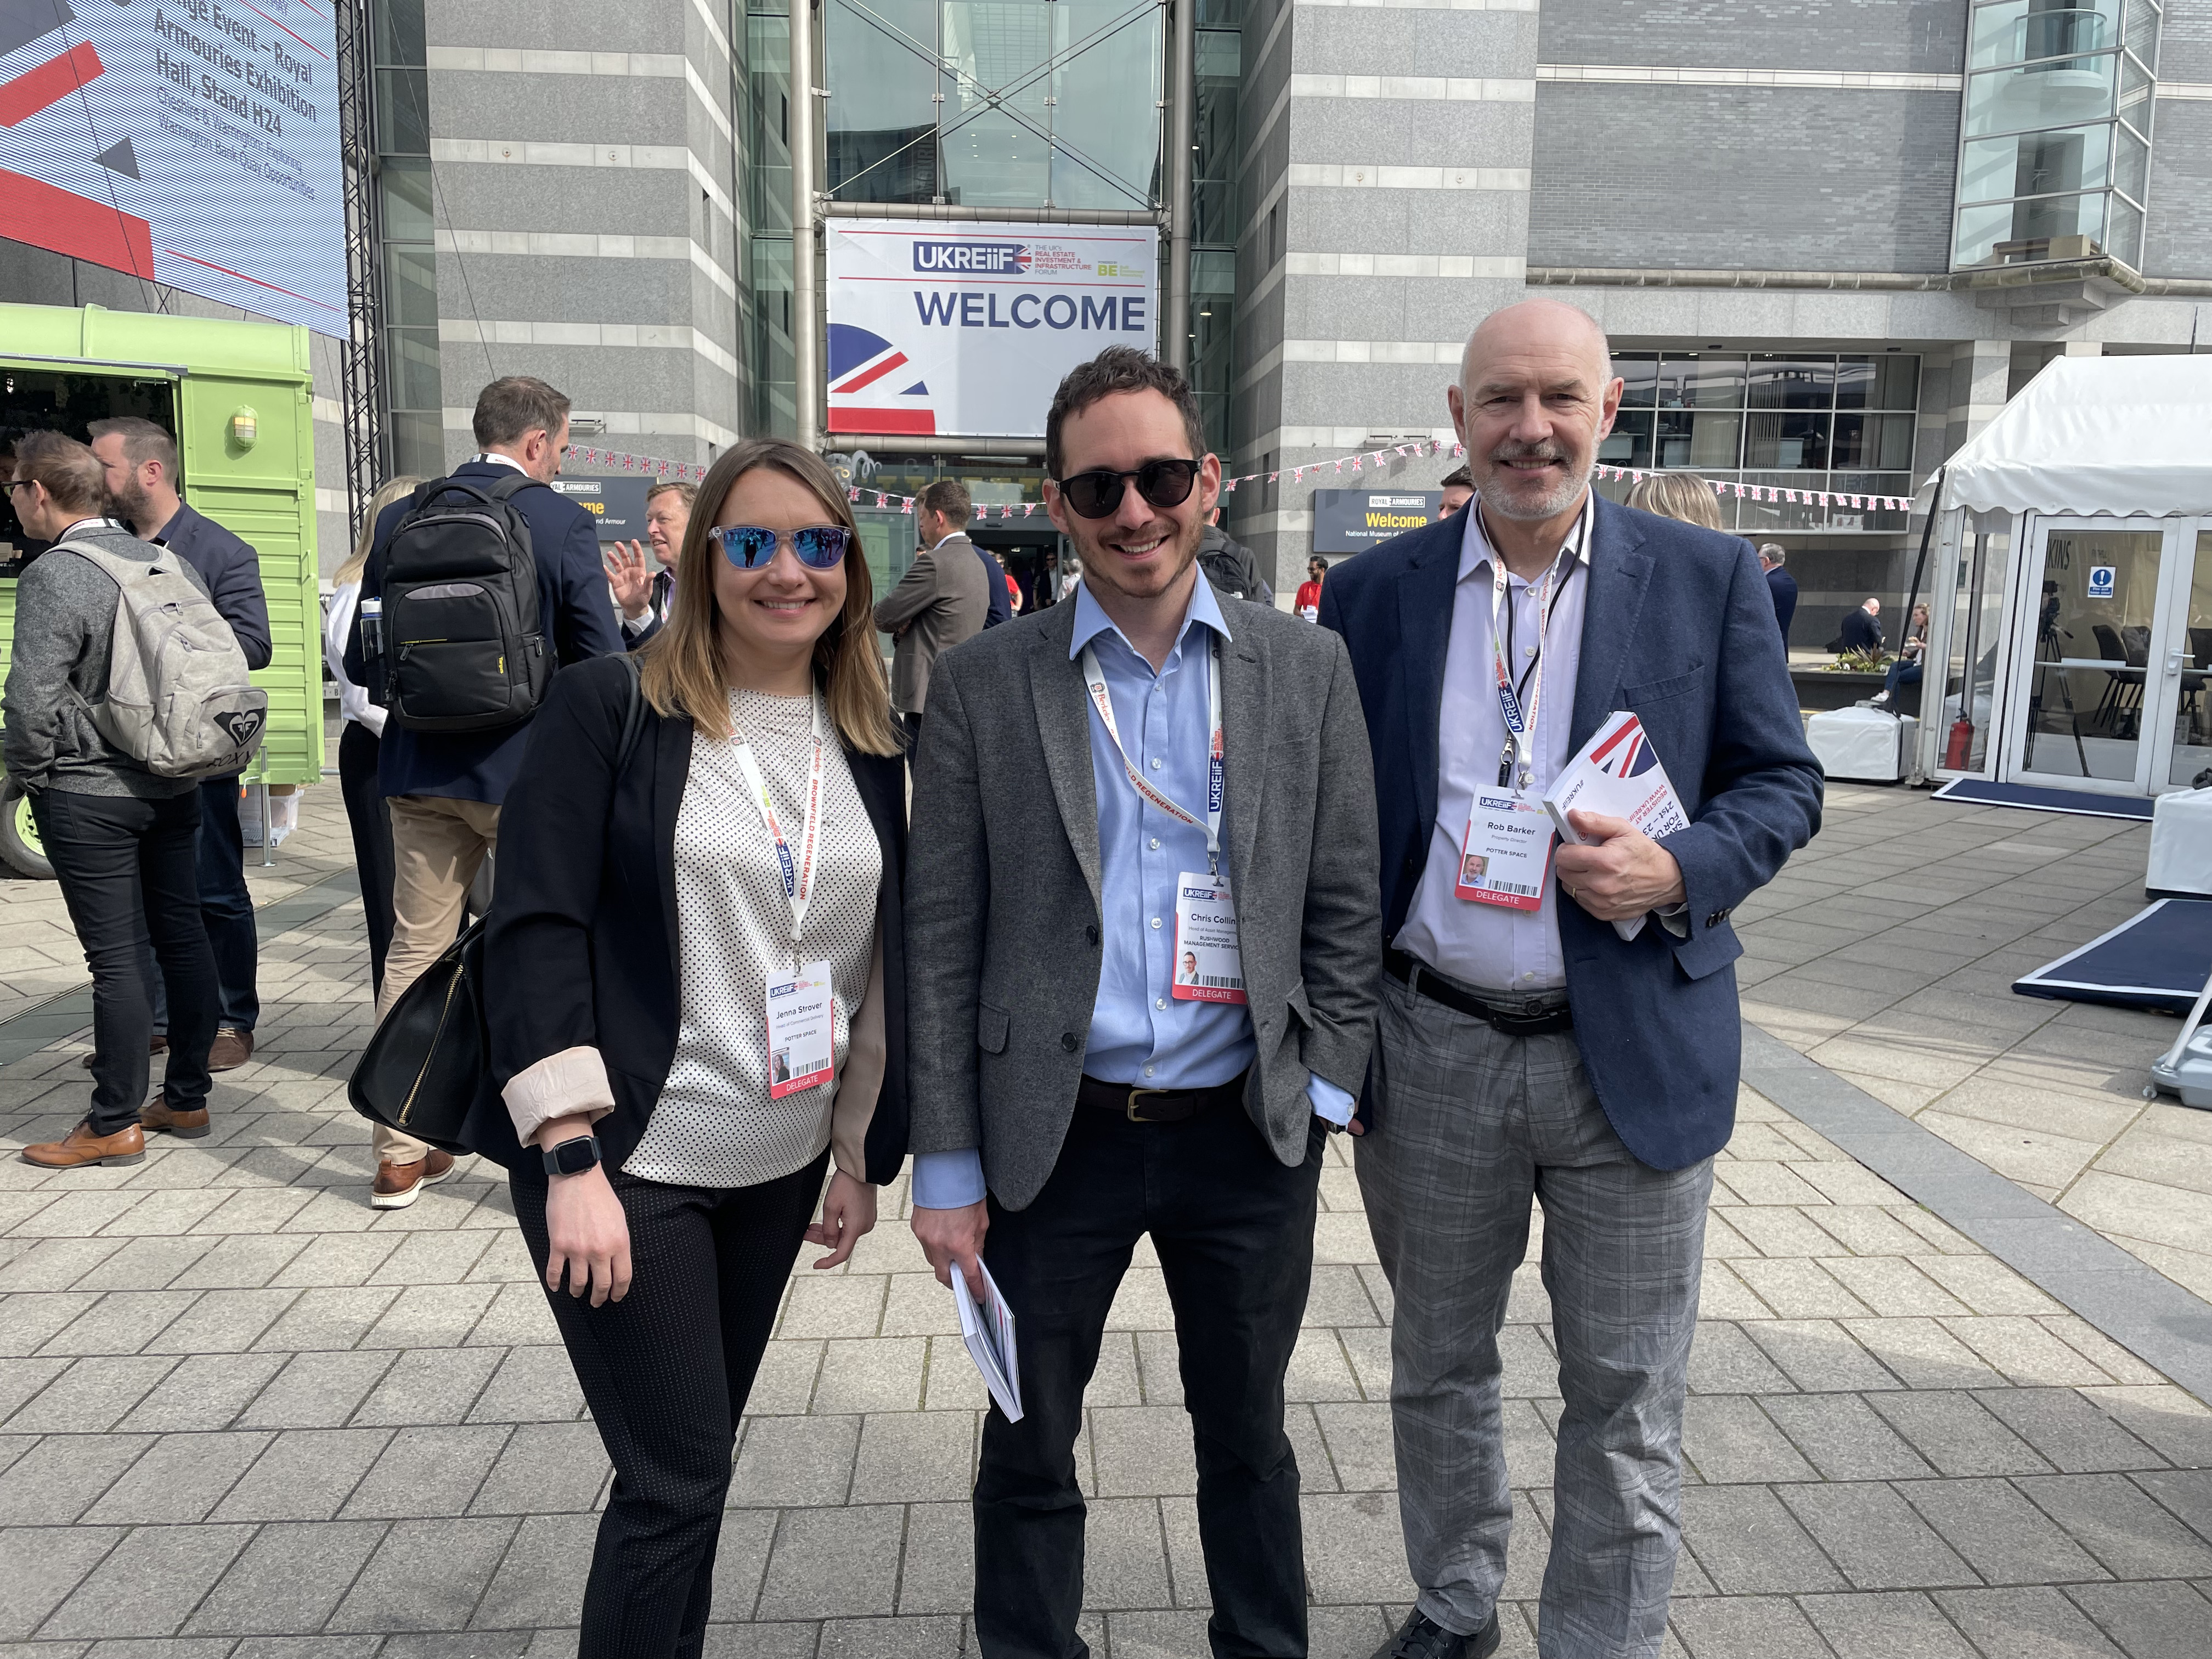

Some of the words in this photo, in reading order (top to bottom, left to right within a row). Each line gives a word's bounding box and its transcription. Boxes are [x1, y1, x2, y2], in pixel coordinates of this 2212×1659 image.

[213, 4, 257, 52] Event
[274, 41, 312, 85] Royal
[154, 8, 241, 78] Armouries
[247, 61, 316, 122] Exhibition
[156, 48, 196, 97] Hall,
[202, 74, 247, 119] Stand
[253, 101, 281, 137] H24
[918, 246, 1014, 270] UKREiiF
[1098, 264, 1118, 276] BE
[913, 291, 1145, 331] WELCOME
[566, 483, 599, 492] ARMOURIES
[1365, 512, 1427, 528] Welcome
[2047, 539, 2071, 570] KINS
[1098, 693, 1110, 723] Berkeley
[812, 746, 822, 774] Berkeley
[1210, 761, 1222, 810] UKREiiF
[809, 779, 818, 831] BROWNFIELD
[1136, 781, 1193, 824] REGENERATION
[1642, 789, 1667, 818] REGISTER
[1659, 800, 1674, 819] 21st
[1488, 822, 1504, 831] Rob
[1507, 825, 1536, 836] Barker
[1635, 815, 1646, 825] AT
[1663, 812, 1679, 831] FOR
[778, 847, 793, 895] UKREiiF
[800, 833, 814, 900] REGENERATION
[1476, 890, 1520, 905] DELEGATE
[1191, 913, 1211, 922] Chris
[1214, 916, 1235, 924] Collin
[1184, 940, 1220, 949] MANAGEMENT
[1192, 989, 1232, 1000] DELEGATE
[776, 1009, 796, 1019] Jenna
[798, 1002, 822, 1013] Strover
[785, 1034, 802, 1042] POTTER
[803, 1029, 816, 1037] SPACE
[786, 1074, 818, 1091] DELEGATE
